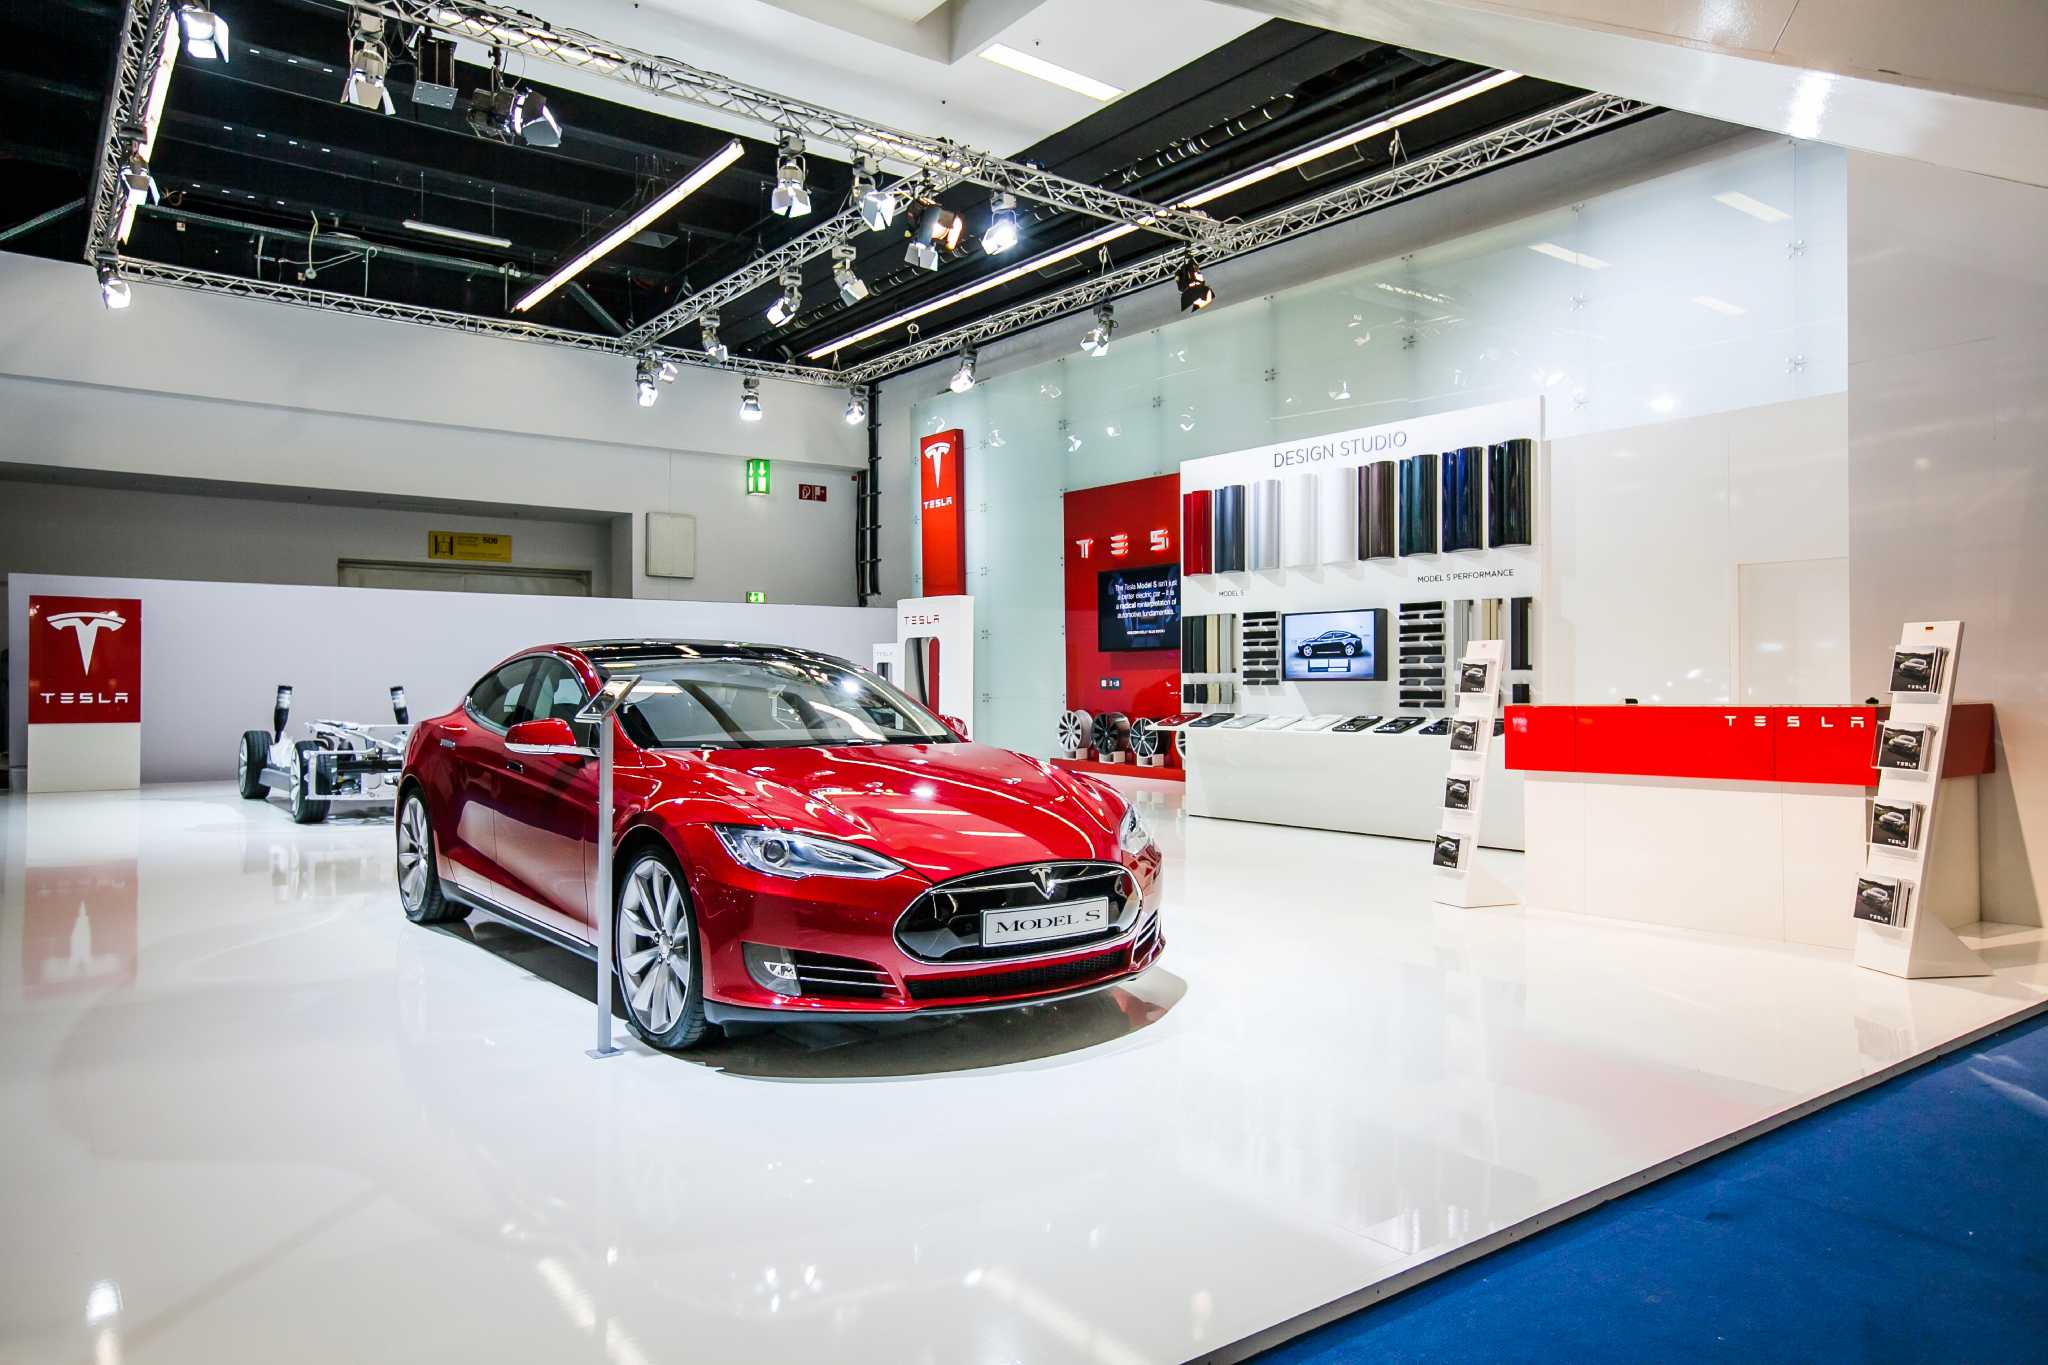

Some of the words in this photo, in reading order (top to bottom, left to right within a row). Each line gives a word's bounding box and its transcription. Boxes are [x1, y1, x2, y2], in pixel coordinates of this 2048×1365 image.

[1274, 442, 1334, 469] DESIGN
[1340, 431, 1407, 457] STUDIO
[923, 496, 953, 510] TESLA
[1417, 574, 1444, 583] MODEL
[1446, 573, 1451, 582] S
[1453, 568, 1515, 580] PERFORMANCE
[1124, 583, 1136, 591] Tesla
[1137, 581, 1152, 590] Model
[1136, 591, 1152, 599] electric
[1120, 601, 1136, 610] radical
[904, 614, 940, 625] TESLA
[40, 692, 129, 704] TESLA
[1724, 715, 1865, 728] TESLA
[995, 914, 1079, 934] MODEL
[1085, 909, 1101, 922] S
